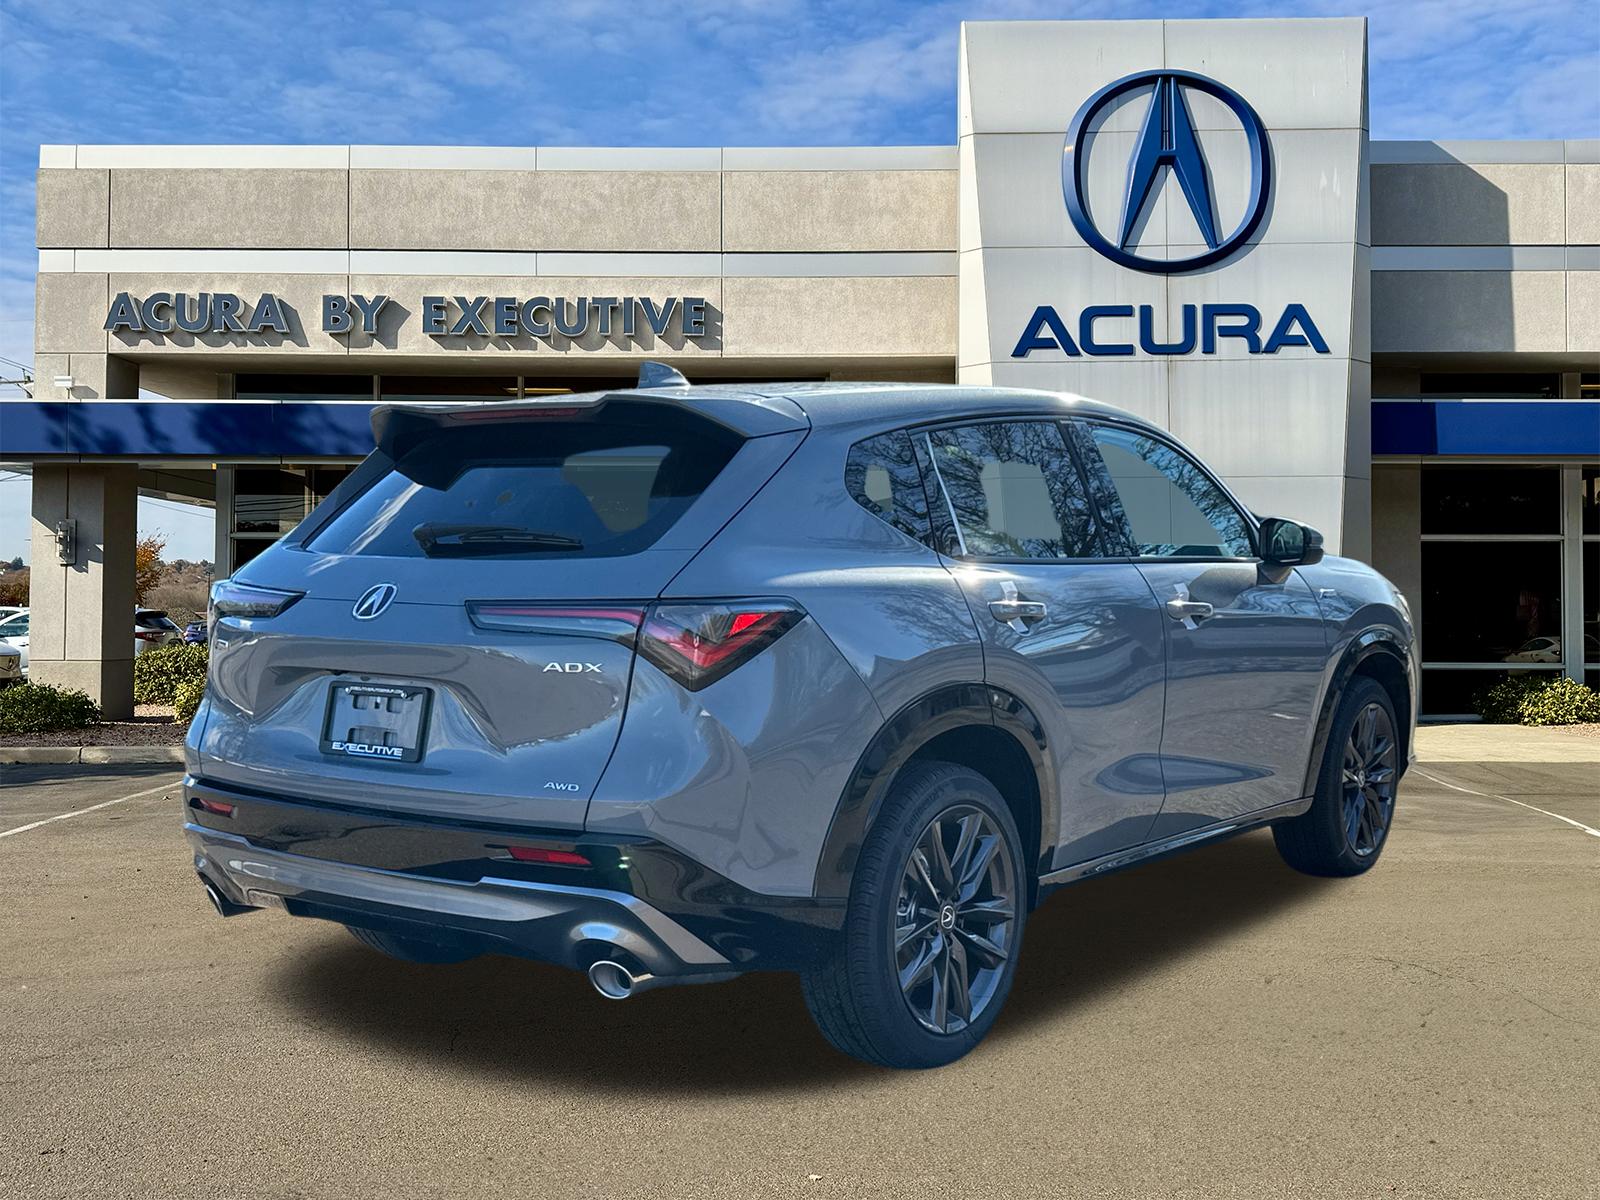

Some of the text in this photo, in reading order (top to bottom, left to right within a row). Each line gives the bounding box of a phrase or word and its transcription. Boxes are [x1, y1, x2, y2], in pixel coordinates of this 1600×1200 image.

[103, 291, 706, 337] ACURA BY EXECUTIVE
[1010, 303, 1332, 358] ACURA
[542, 662, 603, 673] ADX
[331, 741, 404, 758] EXECUTIVE
[543, 781, 580, 792] AWD
